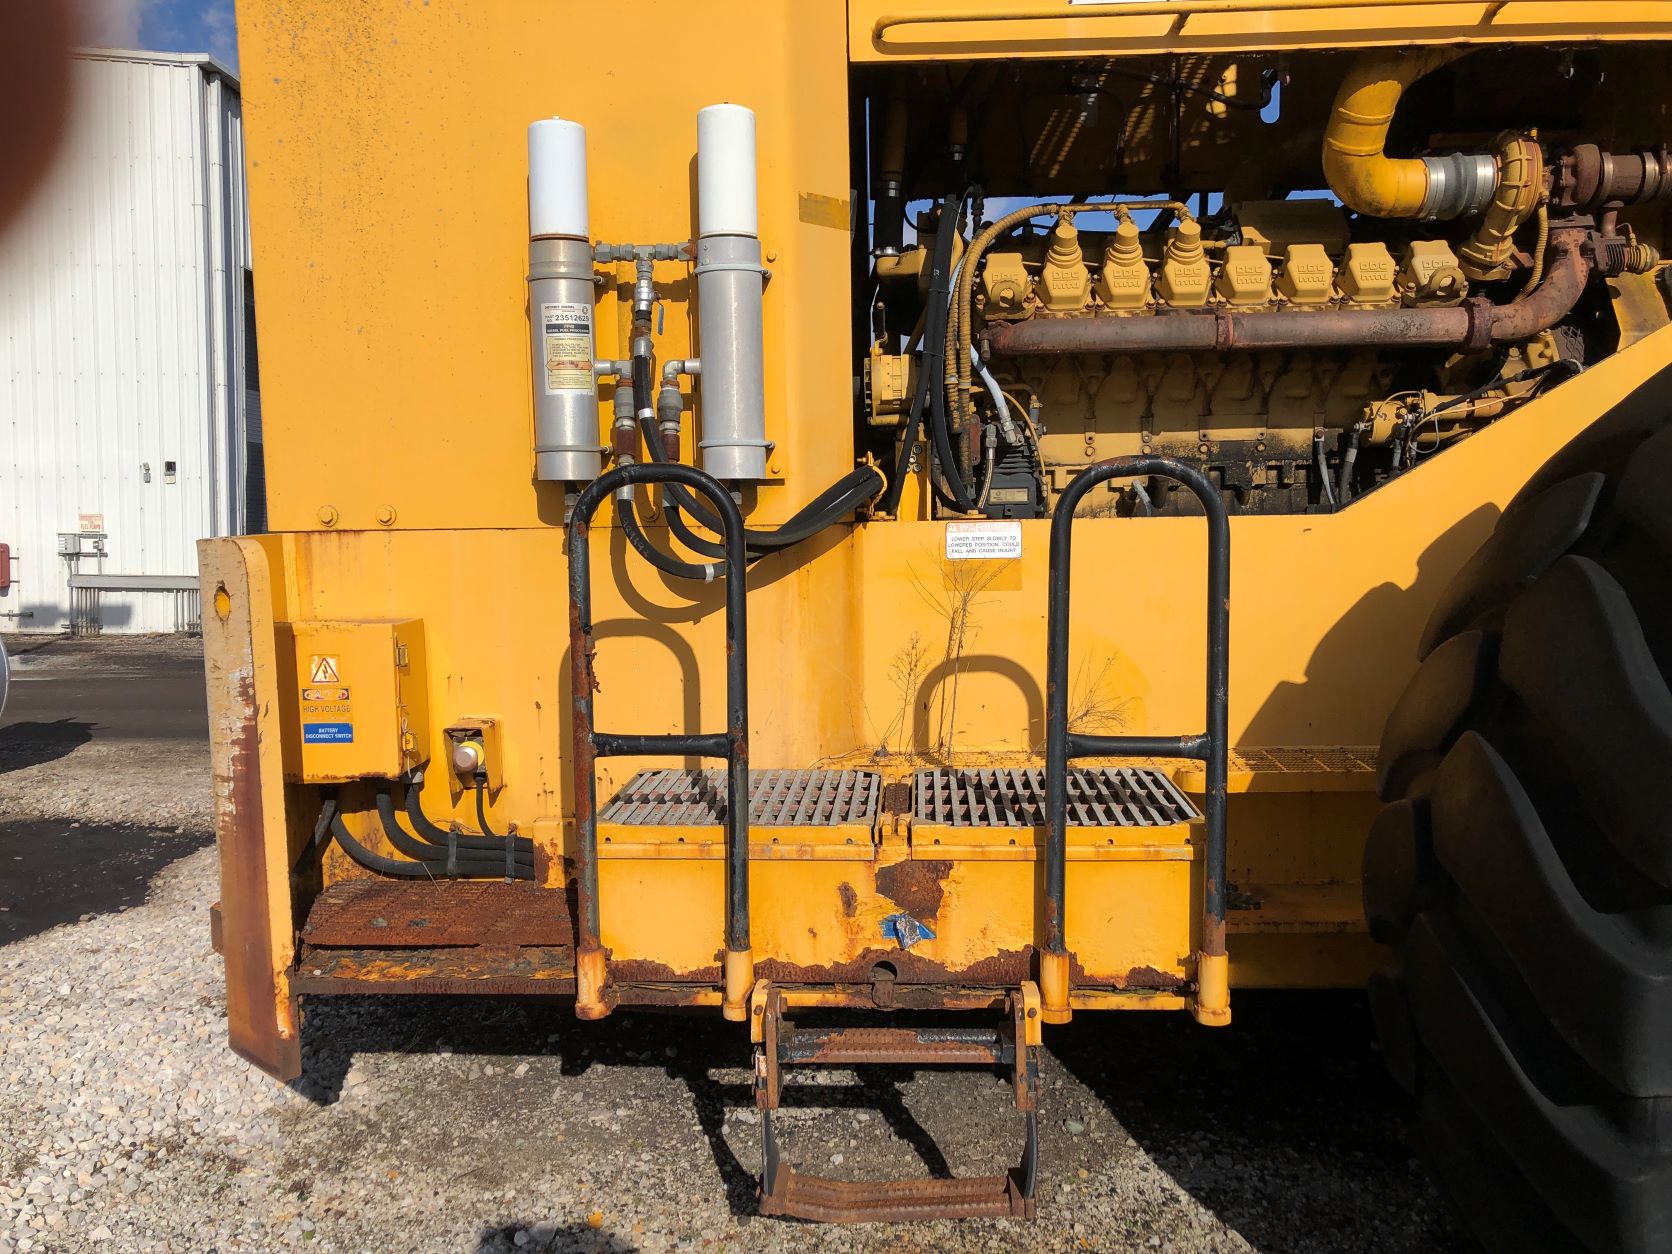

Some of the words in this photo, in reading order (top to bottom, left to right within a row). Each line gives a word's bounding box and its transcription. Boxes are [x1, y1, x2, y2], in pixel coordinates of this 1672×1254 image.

[1235, 265, 1263, 273] DDC
[1297, 264, 1325, 272] DDC
[1359, 261, 1387, 270] DDC
[1052, 271, 1079, 279] DDC
[1113, 269, 1140, 277] DDC
[1174, 267, 1200, 275] DDC
[960, 523, 1008, 531] WARNING
